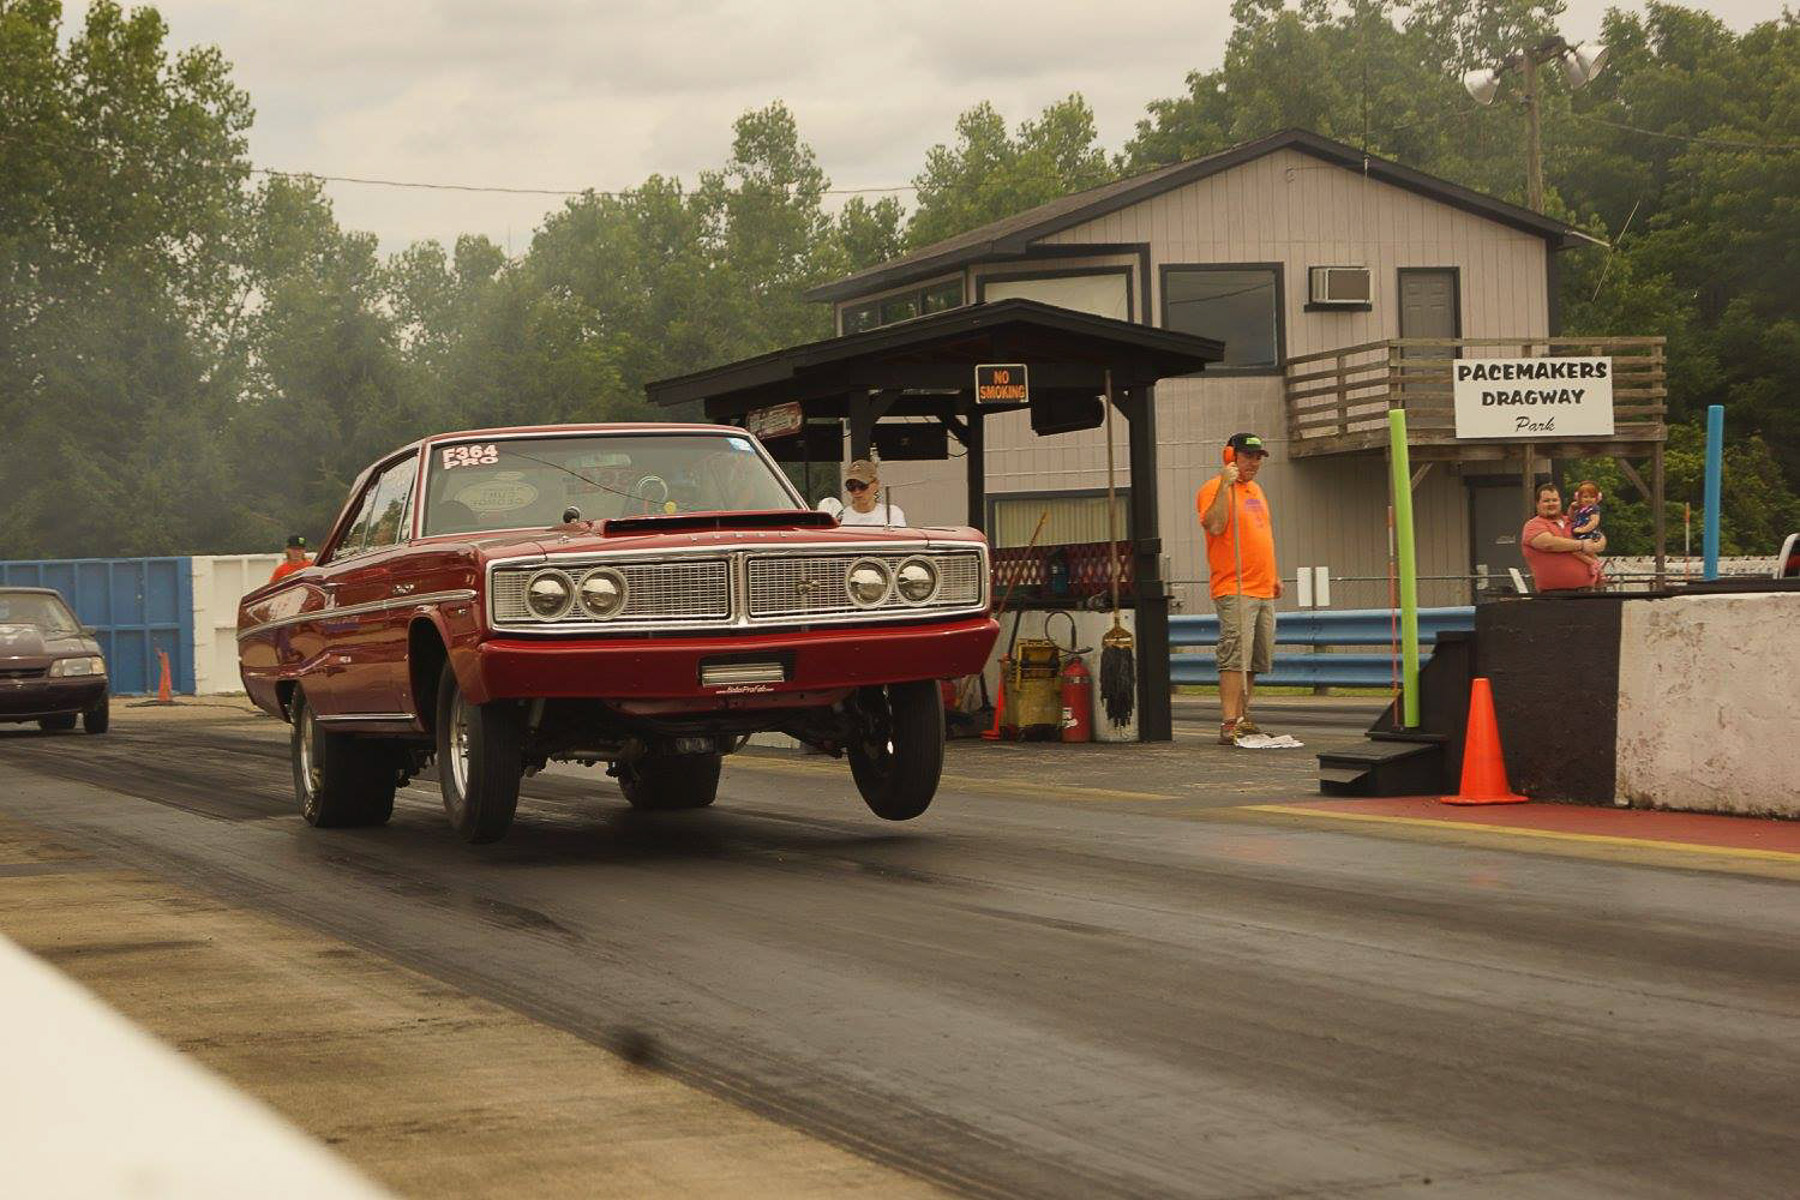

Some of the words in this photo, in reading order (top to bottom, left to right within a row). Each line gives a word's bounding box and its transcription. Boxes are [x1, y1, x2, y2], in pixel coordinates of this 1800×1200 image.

[993, 370, 1009, 385] NO
[1458, 362, 1607, 381] PACEMAKERS
[980, 385, 1025, 399] SMOKING
[1481, 389, 1585, 406] DRAGWAY
[1515, 415, 1556, 433] Park
[442, 444, 498, 462] F364
[443, 456, 499, 470] PRO
